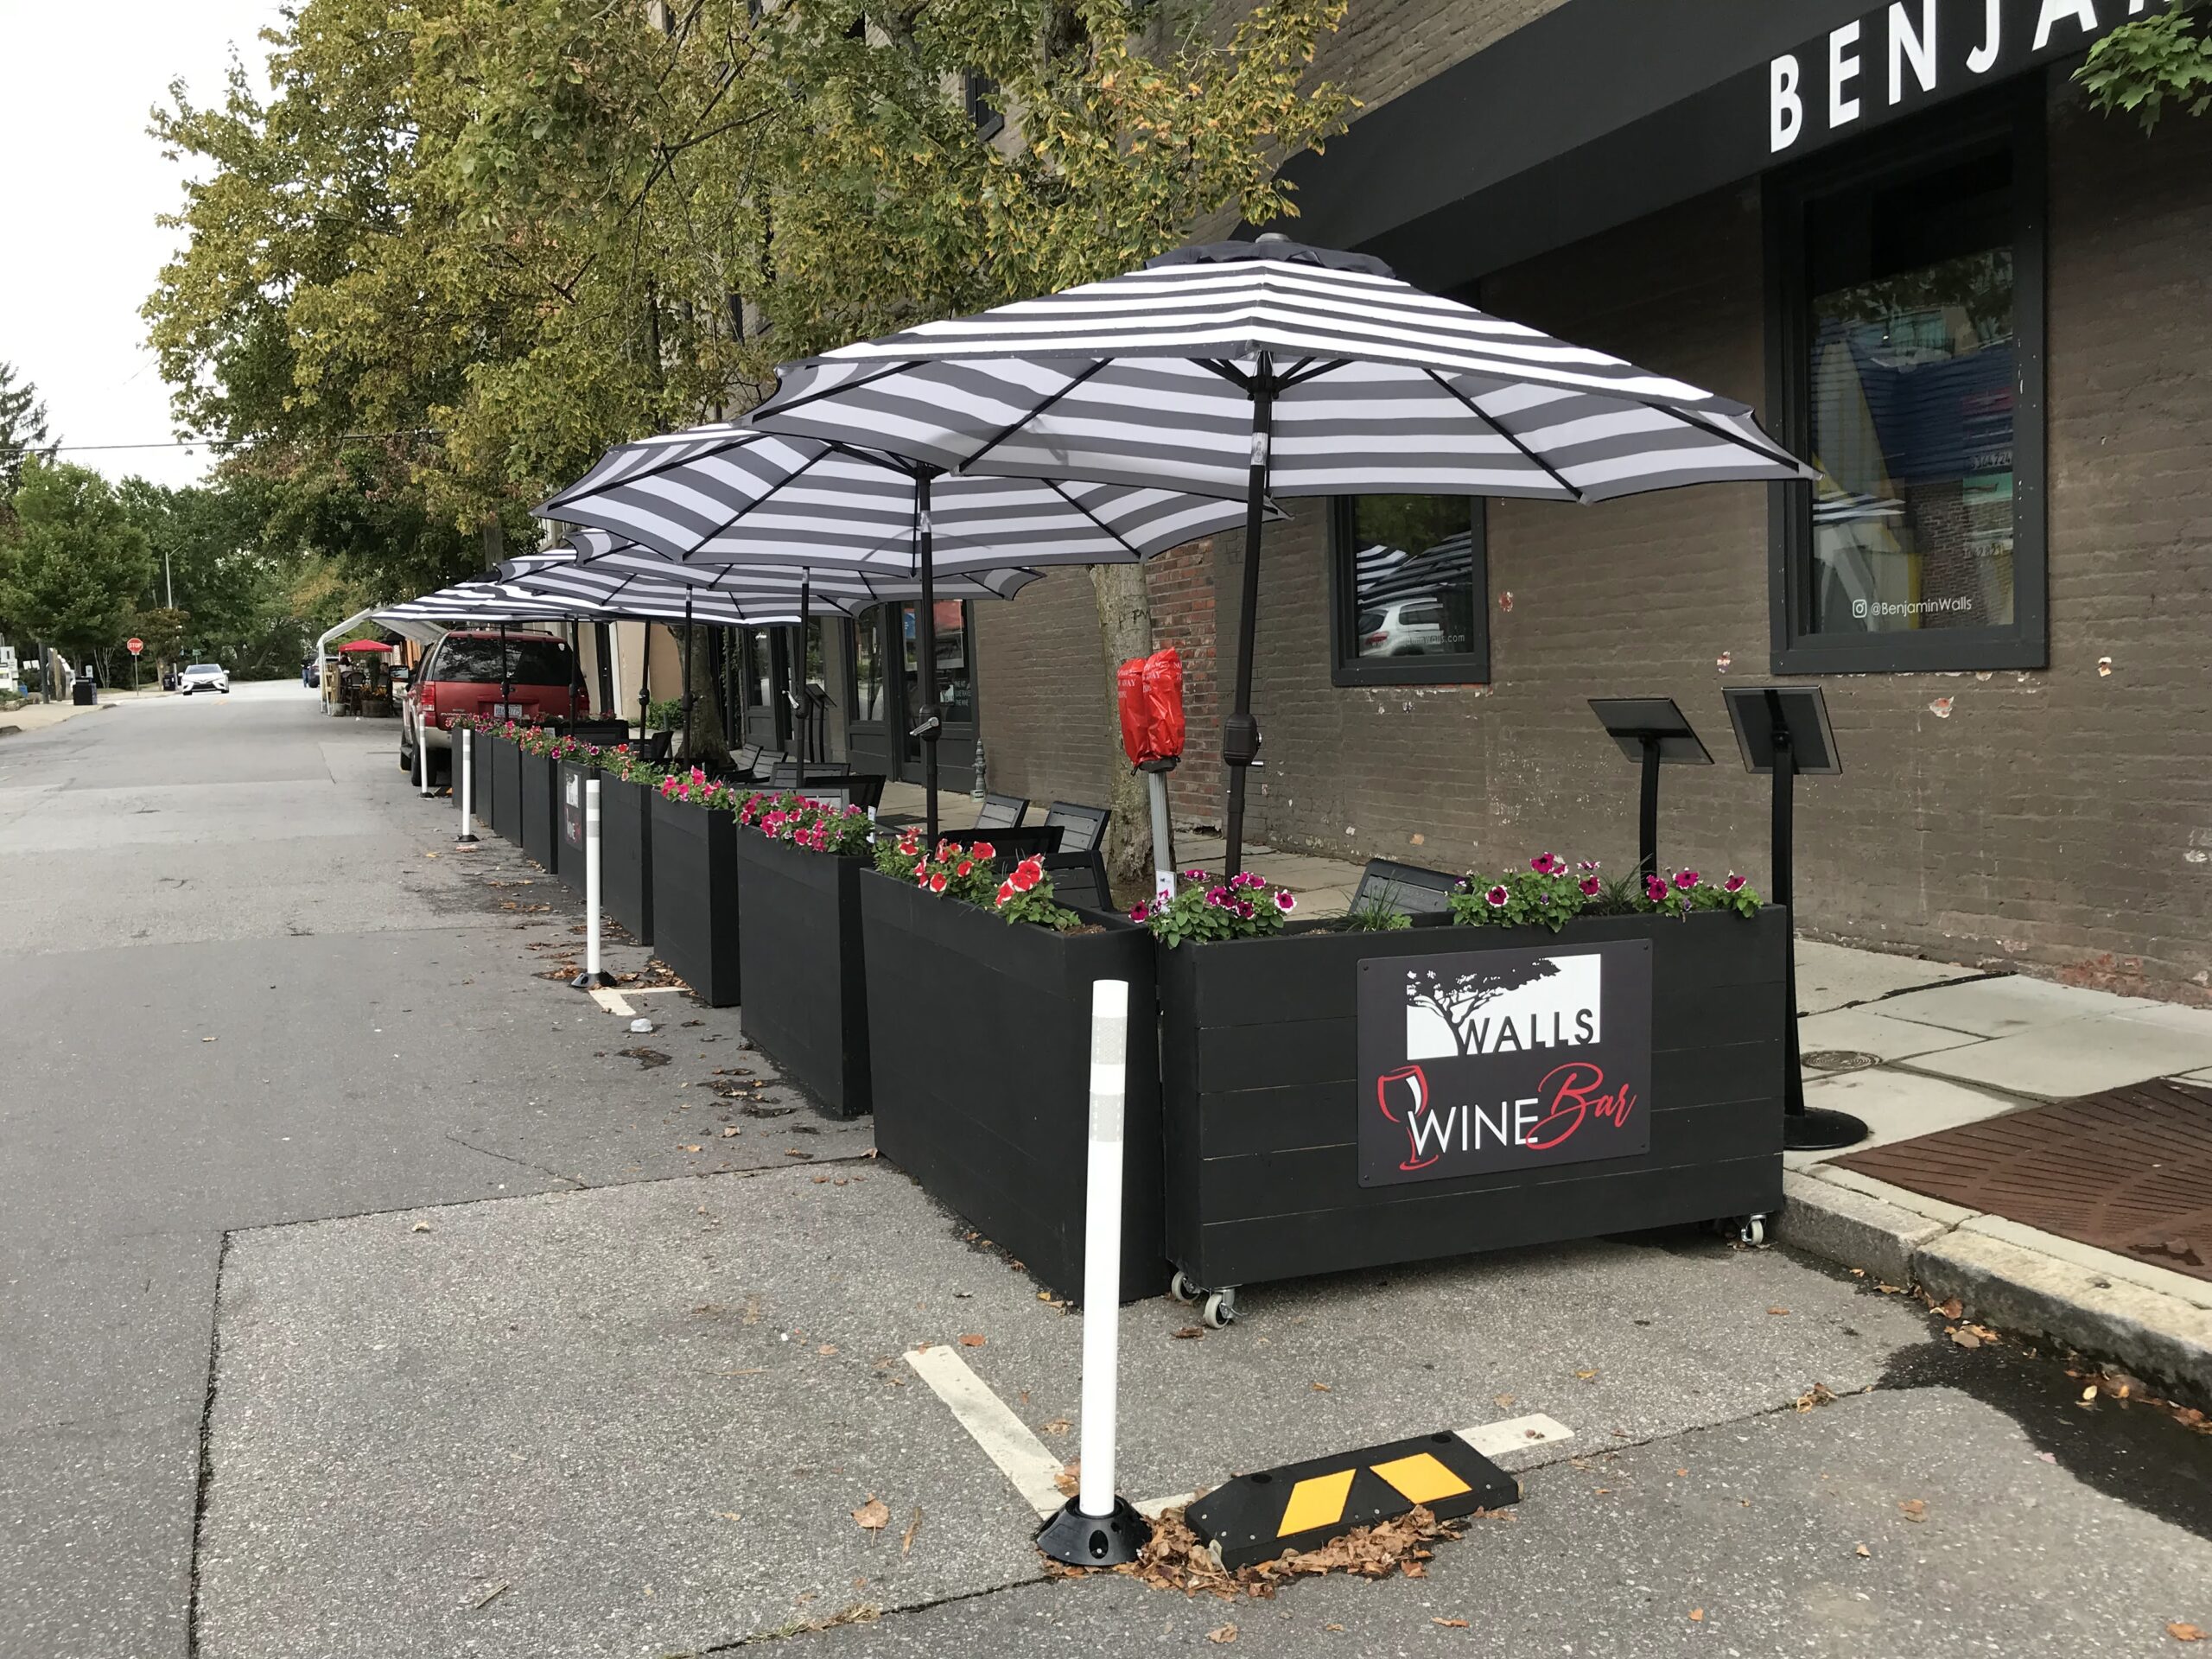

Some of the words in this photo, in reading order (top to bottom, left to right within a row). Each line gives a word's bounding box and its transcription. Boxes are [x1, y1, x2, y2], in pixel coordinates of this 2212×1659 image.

[1770, 0, 2171, 154] BENJA
[1871, 596, 1972, 617] @BenjaminWalls
[1459, 1008, 1594, 1056] WALLS
[1407, 1098, 1539, 1156] WINE
[1526, 1062, 1637, 1149] Bar
